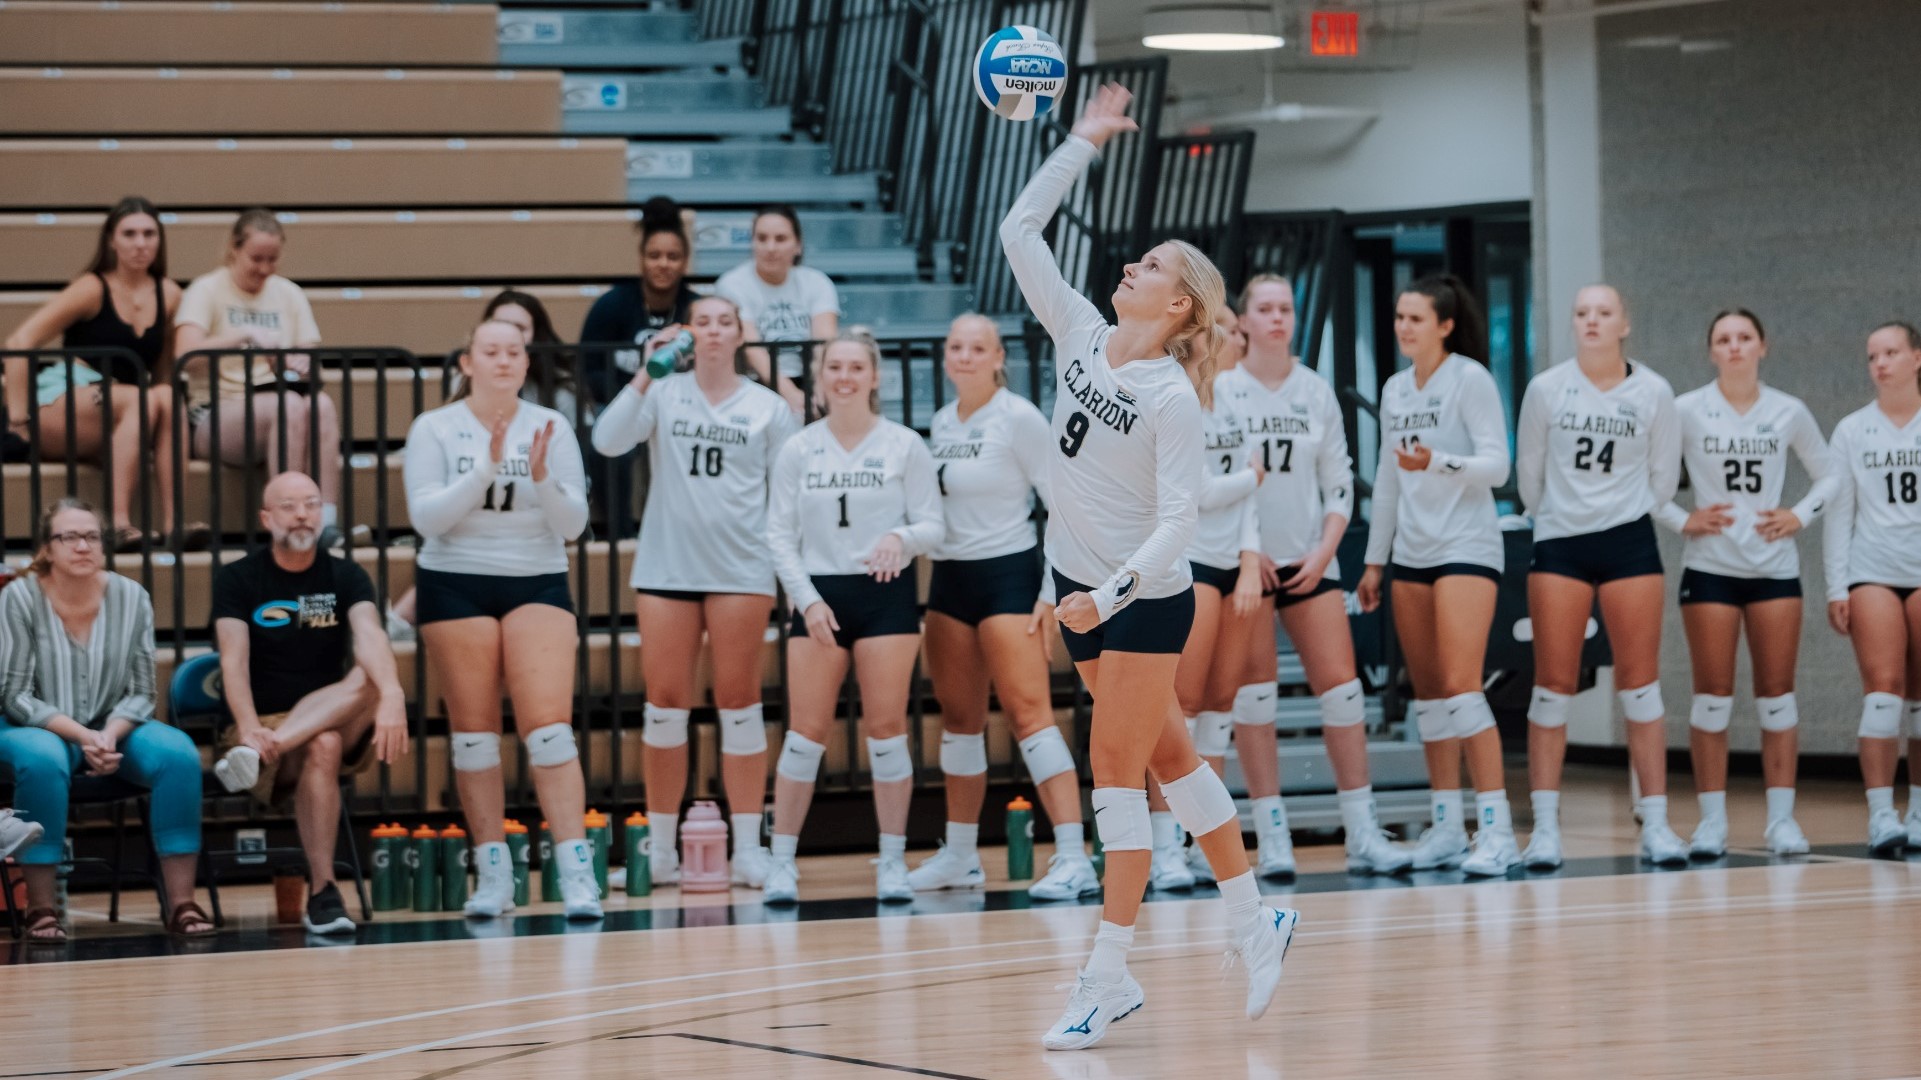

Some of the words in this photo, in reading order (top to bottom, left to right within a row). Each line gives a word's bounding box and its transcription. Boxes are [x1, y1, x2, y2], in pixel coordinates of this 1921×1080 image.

[1010, 58, 1053, 75] NCAA
[1005, 78, 1056, 93] molten
[1064, 359, 1138, 435] CLARION
[671, 420, 749, 446] CLARION
[1060, 411, 1090, 459] 9
[1248, 417, 1311, 434] LARION
[1559, 413, 1637, 439] CLARION
[1262, 440, 1294, 473] 17
[1574, 437, 1615, 474] 24
[1703, 436, 1780, 456] CLARION
[689, 446, 723, 478] 10
[1723, 460, 1763, 494] 25
[806, 471, 884, 489] CLARION
[1884, 471, 1918, 504] 18
[482, 481, 516, 512] 11
[837, 493, 850, 528] 1
